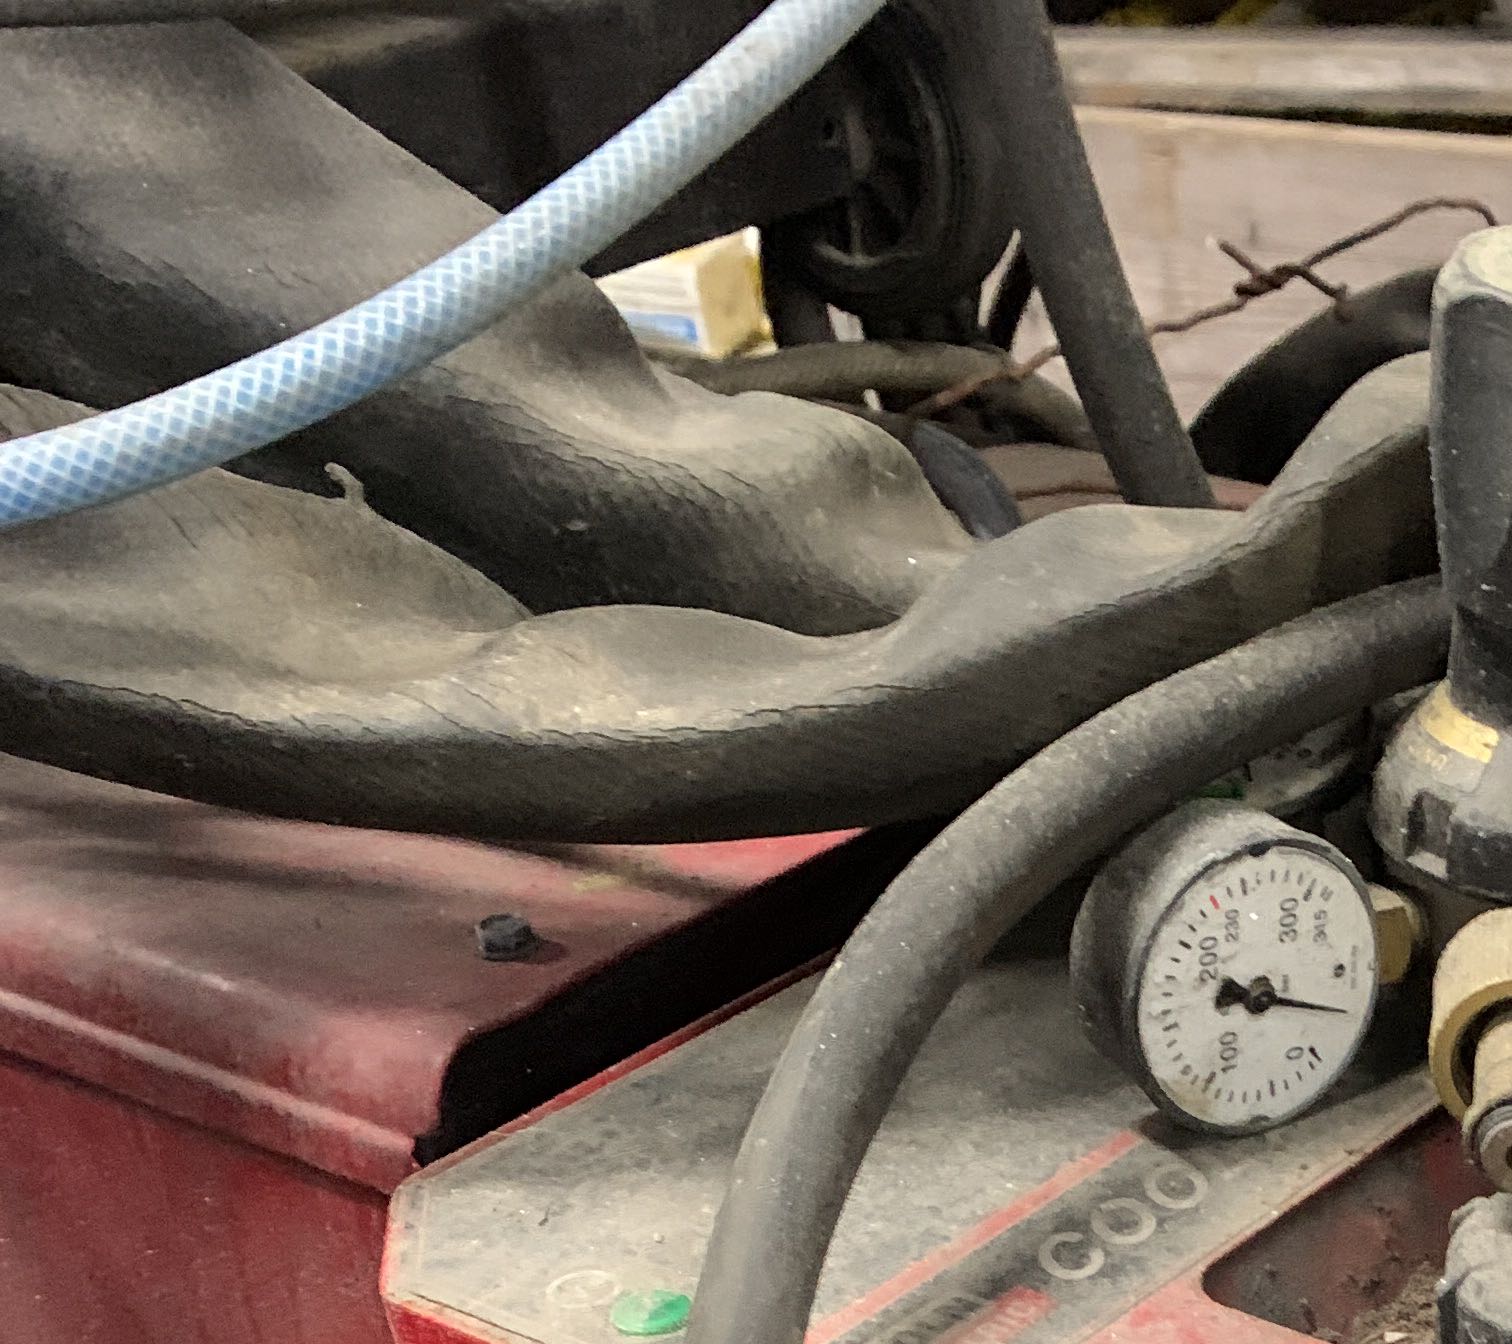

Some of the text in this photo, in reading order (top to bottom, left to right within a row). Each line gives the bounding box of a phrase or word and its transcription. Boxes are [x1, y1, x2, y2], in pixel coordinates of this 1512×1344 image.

[1225, 908, 1241, 943] 230
[1279, 897, 1300, 944] 300
[1198, 936, 1220, 983] 200
[1219, 1031, 1239, 1075] 100
[1285, 1046, 1304, 1061] 0
